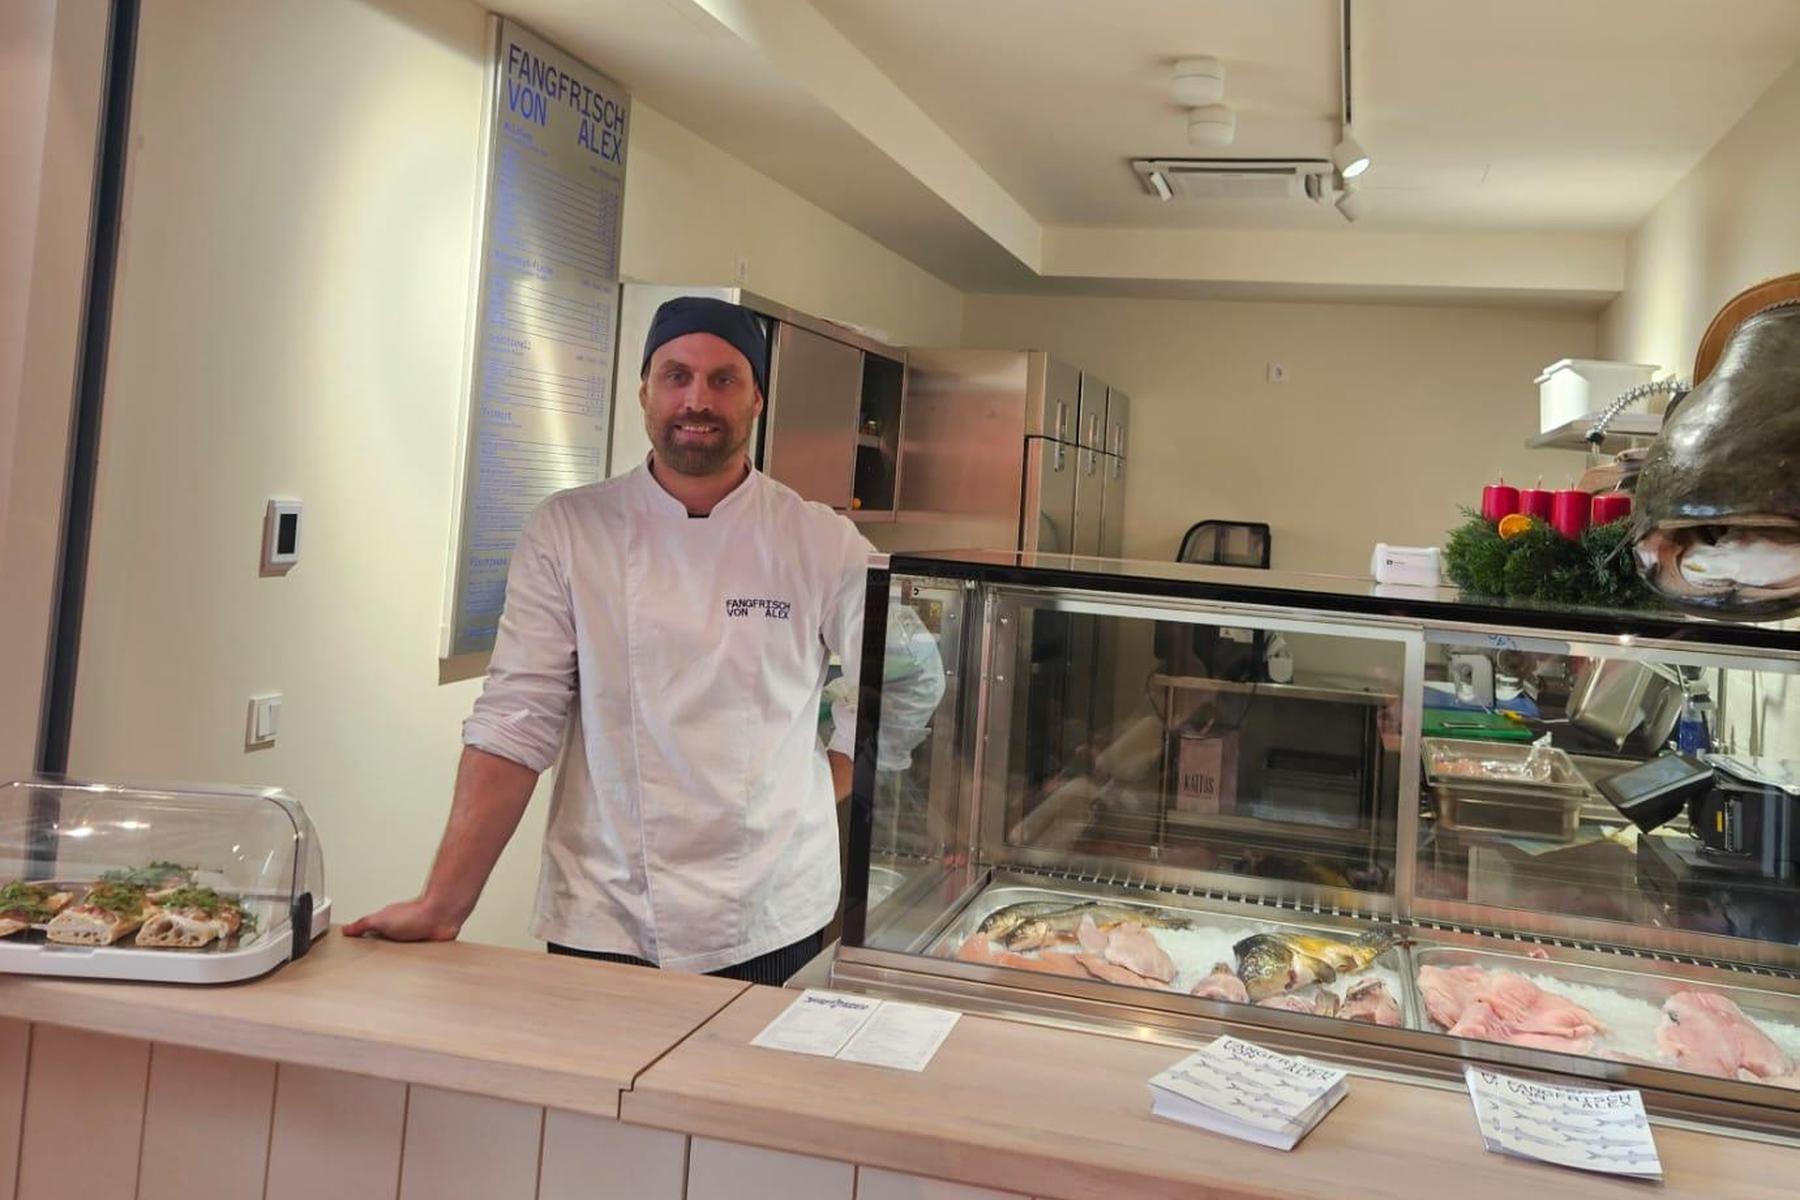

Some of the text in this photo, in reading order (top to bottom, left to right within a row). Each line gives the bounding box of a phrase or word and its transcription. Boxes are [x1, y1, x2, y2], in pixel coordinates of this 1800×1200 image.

[508, 43, 625, 135] FANGFRISCH
[508, 79, 547, 128] VON
[578, 120, 622, 165] ALEX
[725, 598, 791, 610] FANGFRISCH
[727, 608, 790, 619] VON ALEX
